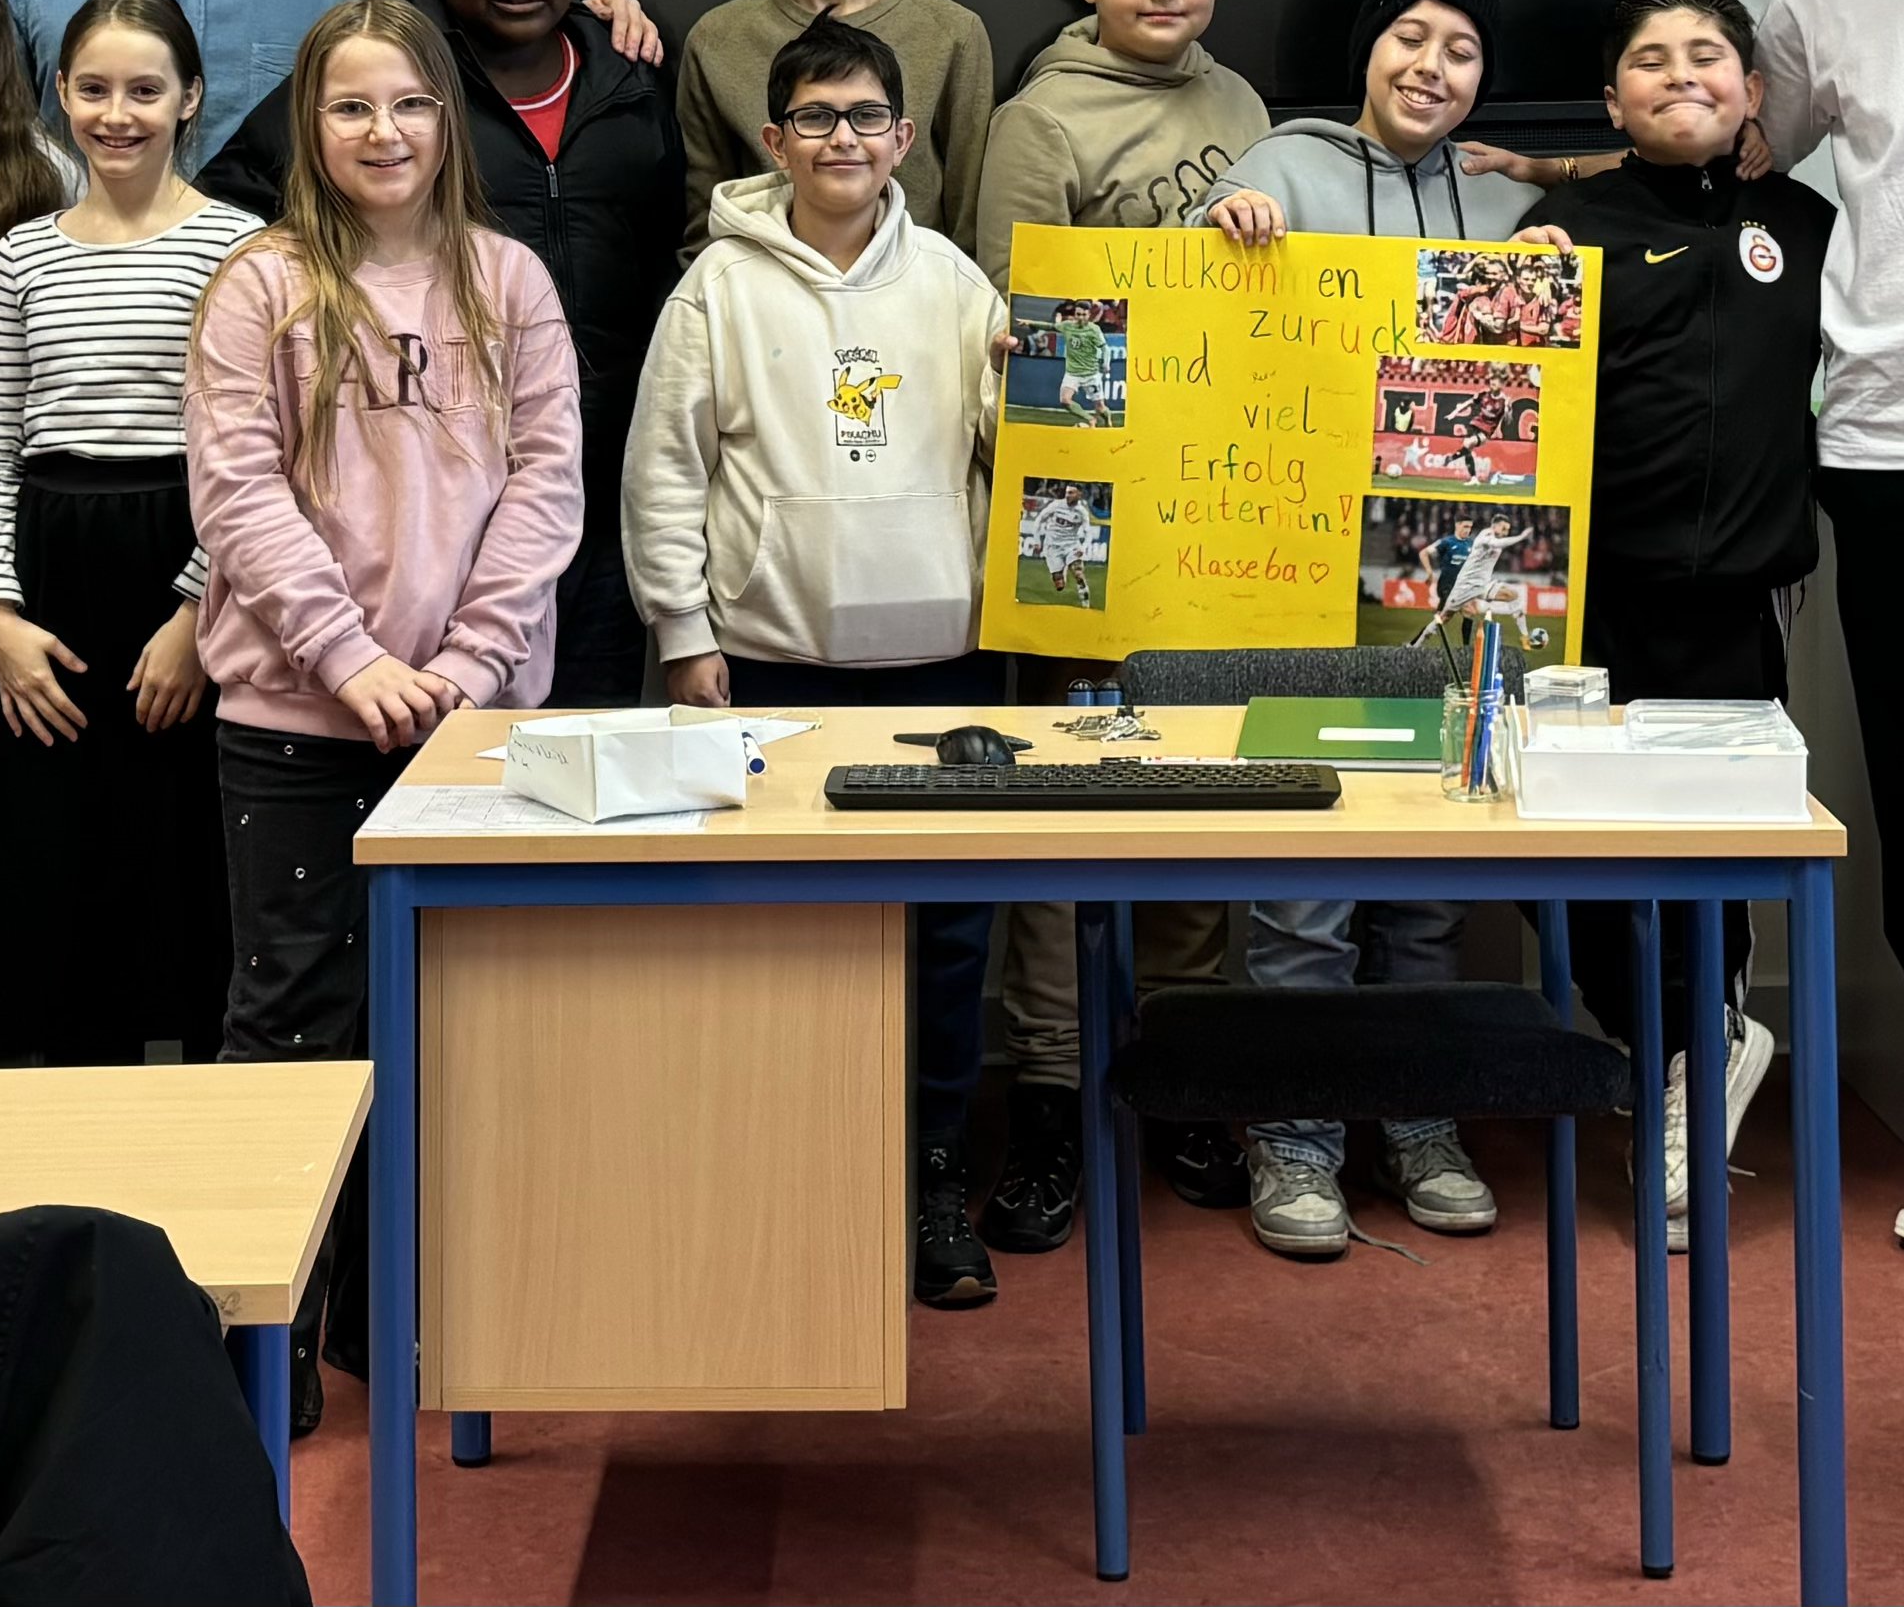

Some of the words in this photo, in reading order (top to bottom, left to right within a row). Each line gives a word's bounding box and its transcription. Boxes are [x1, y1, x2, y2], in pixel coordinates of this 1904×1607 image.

[1105, 236, 1364, 299] Willkomen
[1134, 331, 1211, 387] und
[1243, 385, 1317, 434] viel
[1181, 443, 1307, 504] Erfolg
